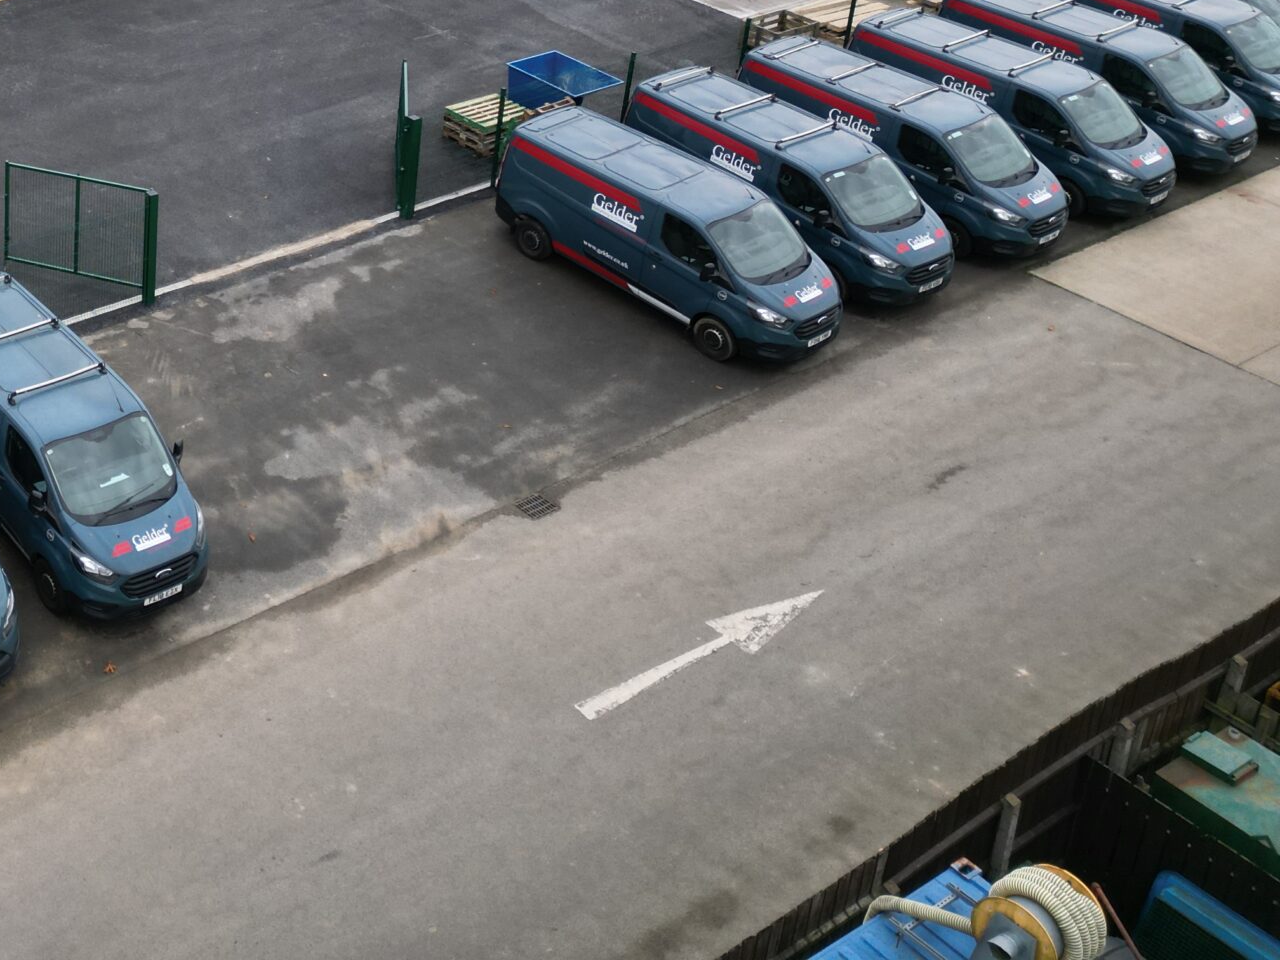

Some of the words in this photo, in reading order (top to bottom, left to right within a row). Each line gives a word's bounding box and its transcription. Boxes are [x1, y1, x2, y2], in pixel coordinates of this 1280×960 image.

[941, 74, 990, 102] Gelder
[828, 107, 876, 137] Gelder
[712, 144, 757, 175] Gelder
[592, 192, 640, 226] Gelder
[131, 527, 168, 547] Gelder
